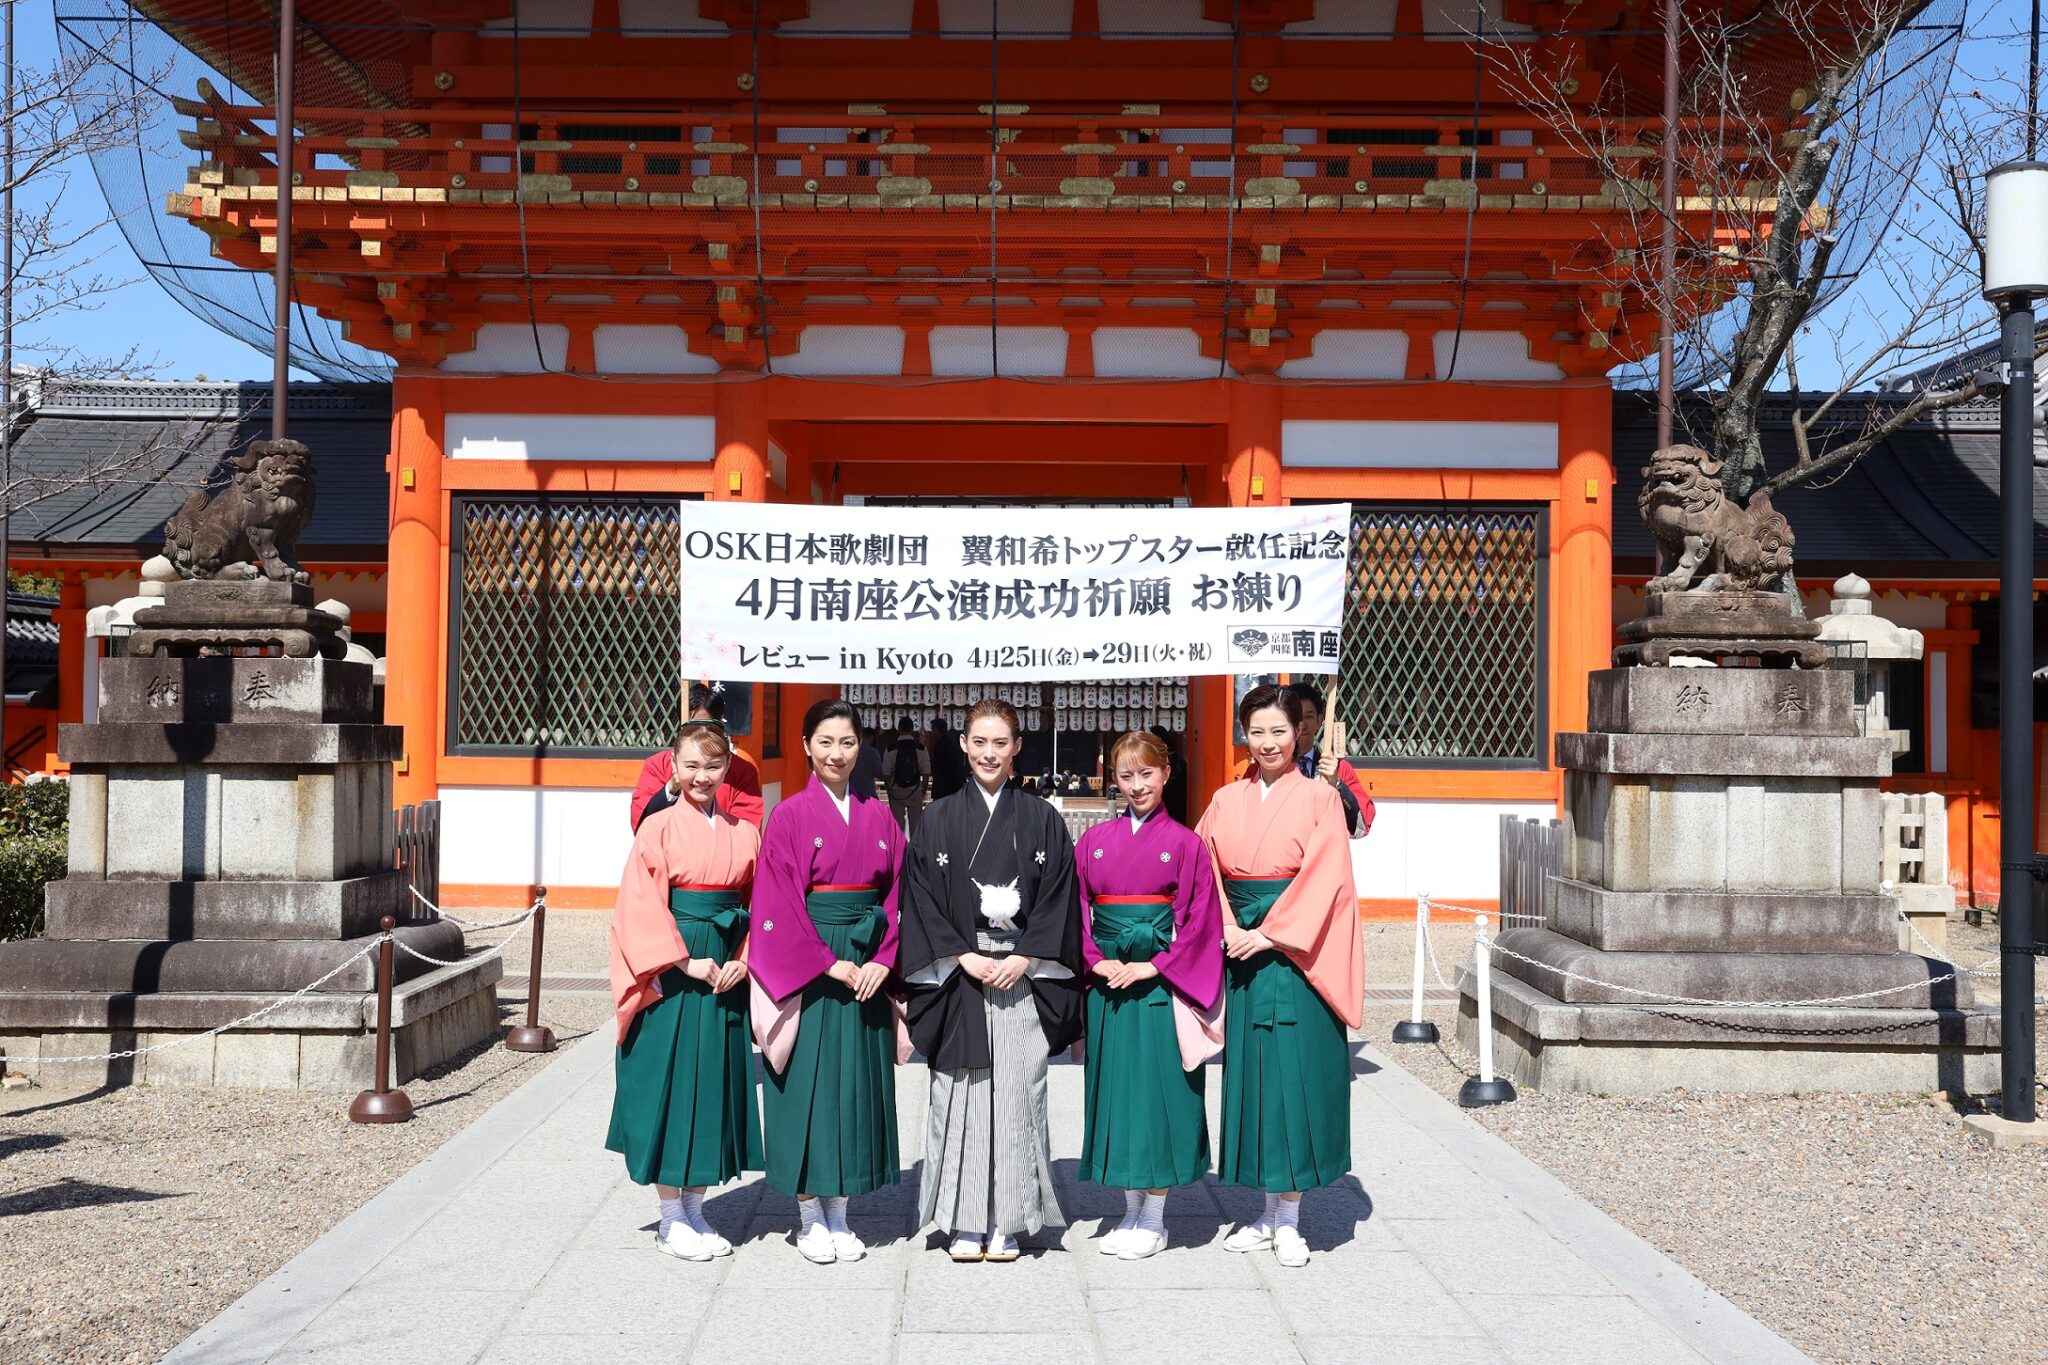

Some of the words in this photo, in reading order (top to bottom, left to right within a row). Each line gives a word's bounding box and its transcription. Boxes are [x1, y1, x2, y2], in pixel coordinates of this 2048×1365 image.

[685, 530, 929, 566] OSK日本歌劇団
[961, 531, 1347, 567] 翼和希トップスター就任記念
[735, 576, 1172, 622] 4月南座公演成功祈願
[1191, 571, 1302, 613] お練り
[737, 644, 830, 669] レビュー
[839, 646, 867, 670] in
[876, 647, 953, 675] Kyoto
[1291, 629, 1338, 658] 南座
